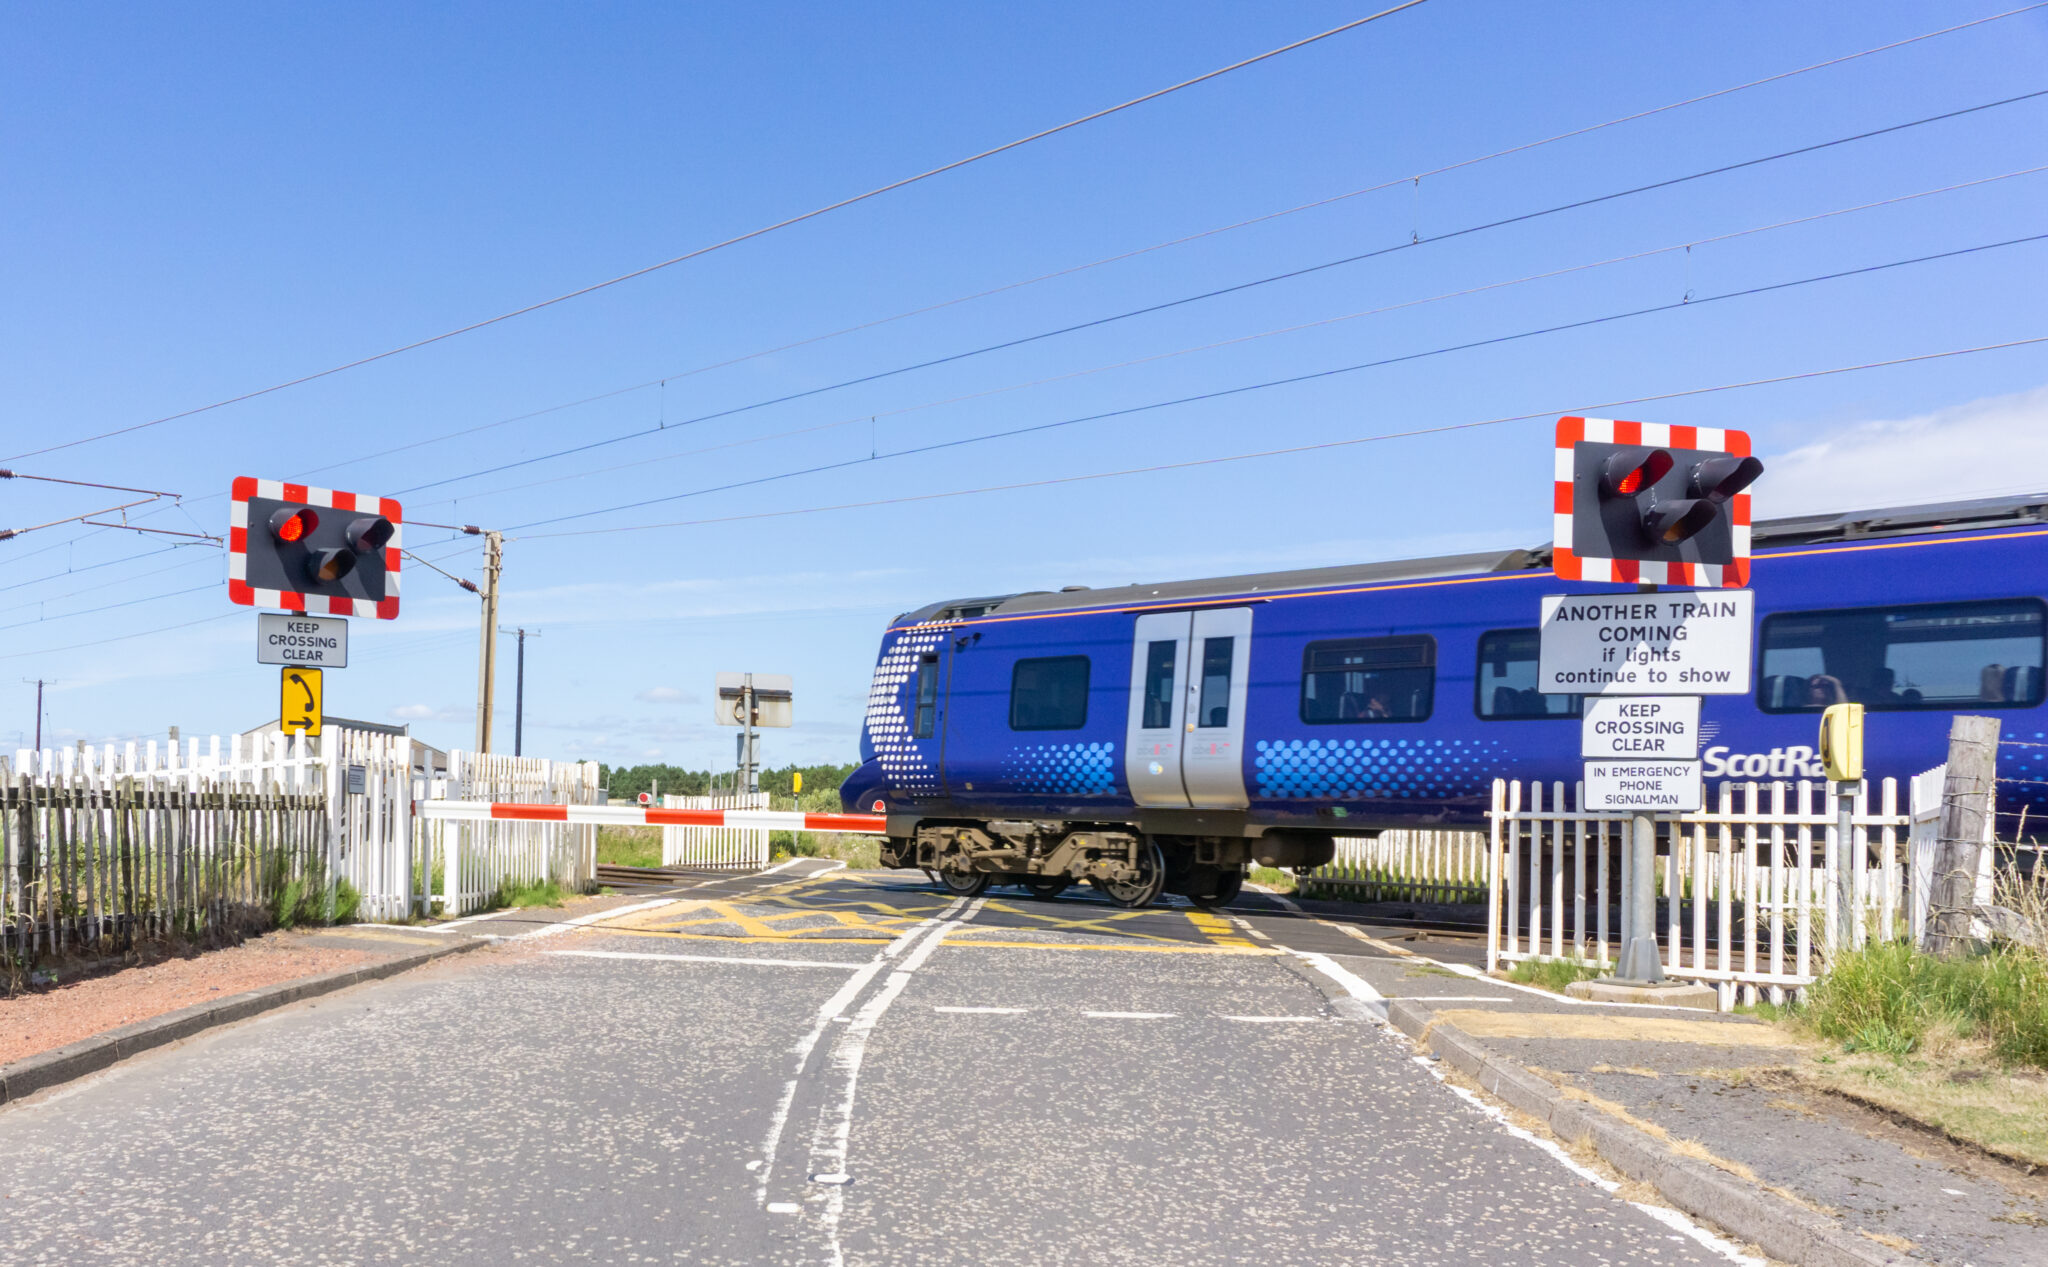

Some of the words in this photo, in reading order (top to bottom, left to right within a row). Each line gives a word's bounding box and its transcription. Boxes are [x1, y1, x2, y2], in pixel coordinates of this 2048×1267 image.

[1555, 603, 1657, 622] ANOTHER
[1668, 601, 1737, 619] TRAIN
[287, 621, 320, 634] KEEP
[1598, 624, 1688, 643] COMING
[268, 634, 338, 649] CROSSING
[282, 648, 324, 661] CLEAR
[1602, 647, 1616, 663] if
[1625, 647, 1682, 666] lights
[1554, 667, 1638, 684] continue
[1648, 668, 1668, 684] to
[1678, 667, 1732, 683] show
[1618, 704, 1662, 718] KEEP
[1594, 721, 1685, 735] CROSSING
[1611, 738, 1666, 752] CLEAR
[1702, 745, 1829, 778] ScotRa
[1593, 767, 1606, 778] IN
[1611, 766, 1691, 778] EMERGENCY
[1619, 781, 1663, 791] PHONE
[1604, 794, 1679, 805] SIGNALMAN
